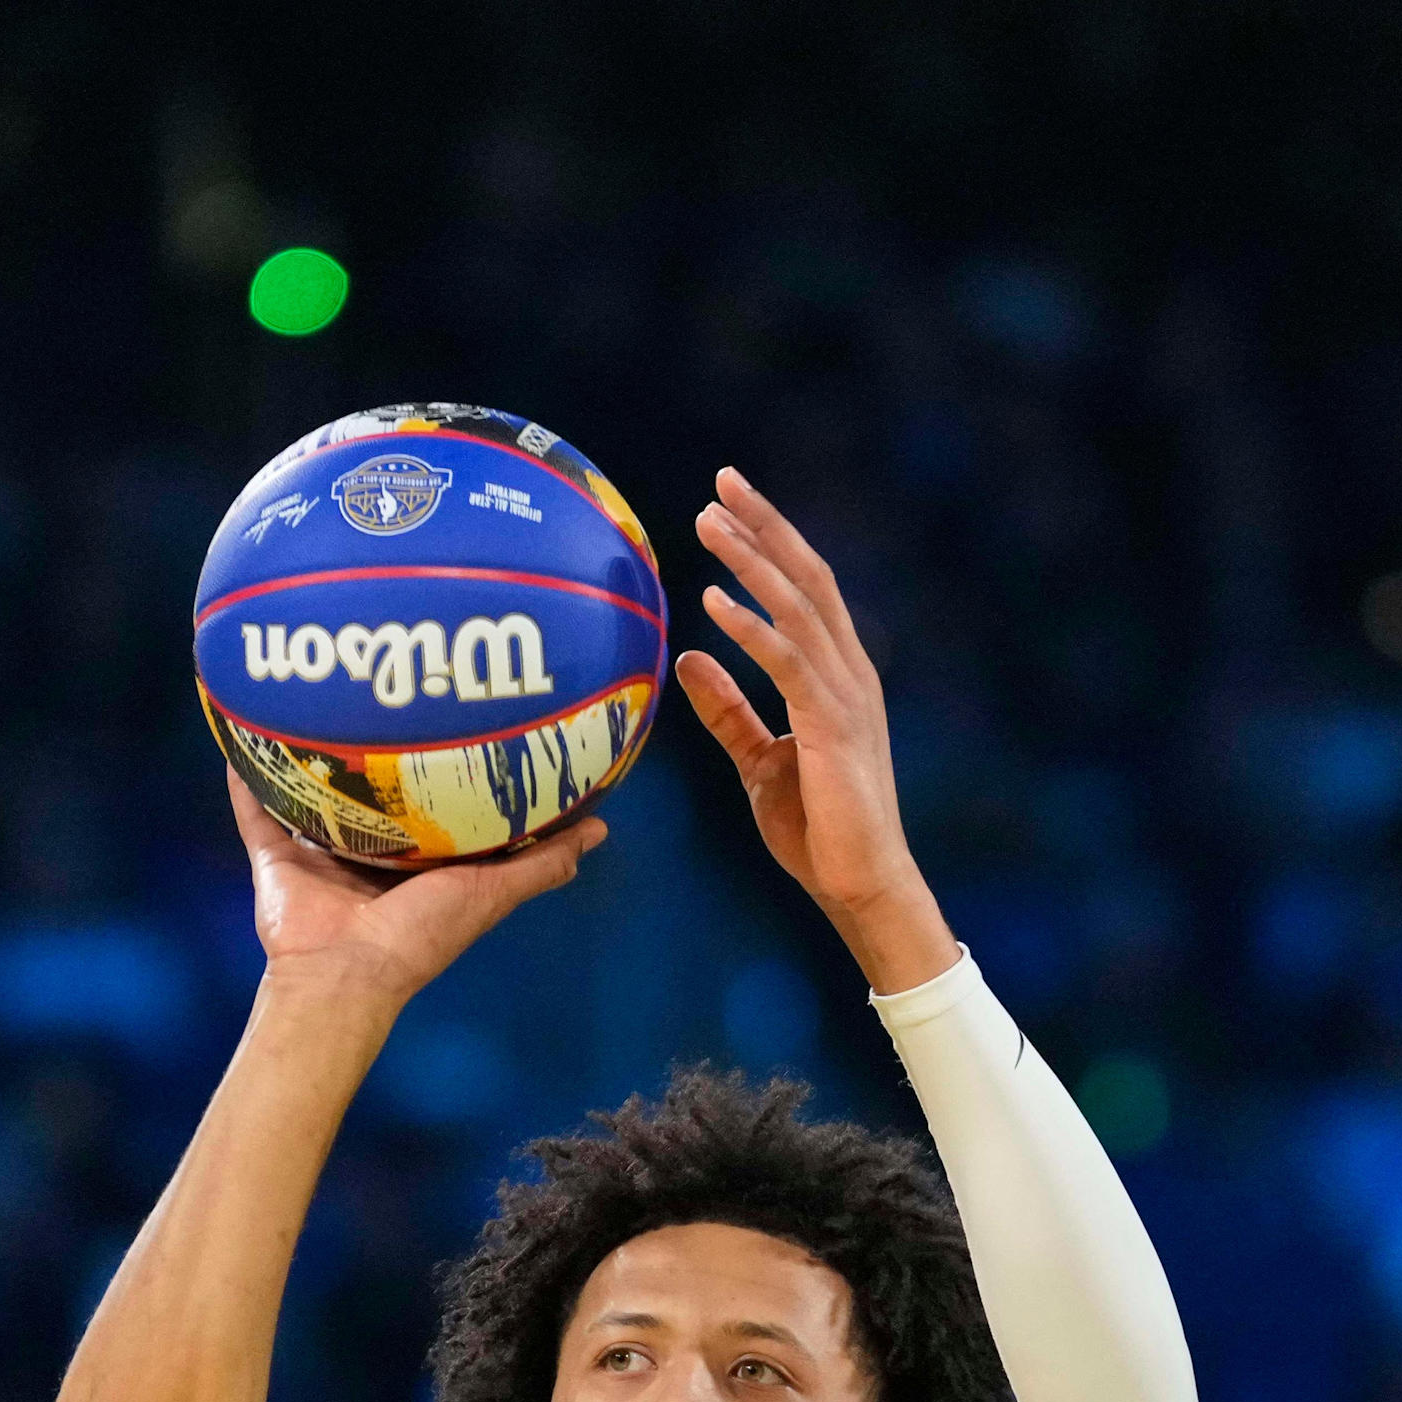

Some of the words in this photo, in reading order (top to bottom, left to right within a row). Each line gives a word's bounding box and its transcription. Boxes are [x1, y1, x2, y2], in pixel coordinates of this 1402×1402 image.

[468, 491, 508, 513] ALL-STAR
[509, 499, 543, 524] OFFICIAL
[241, 612, 554, 708] Wilson
